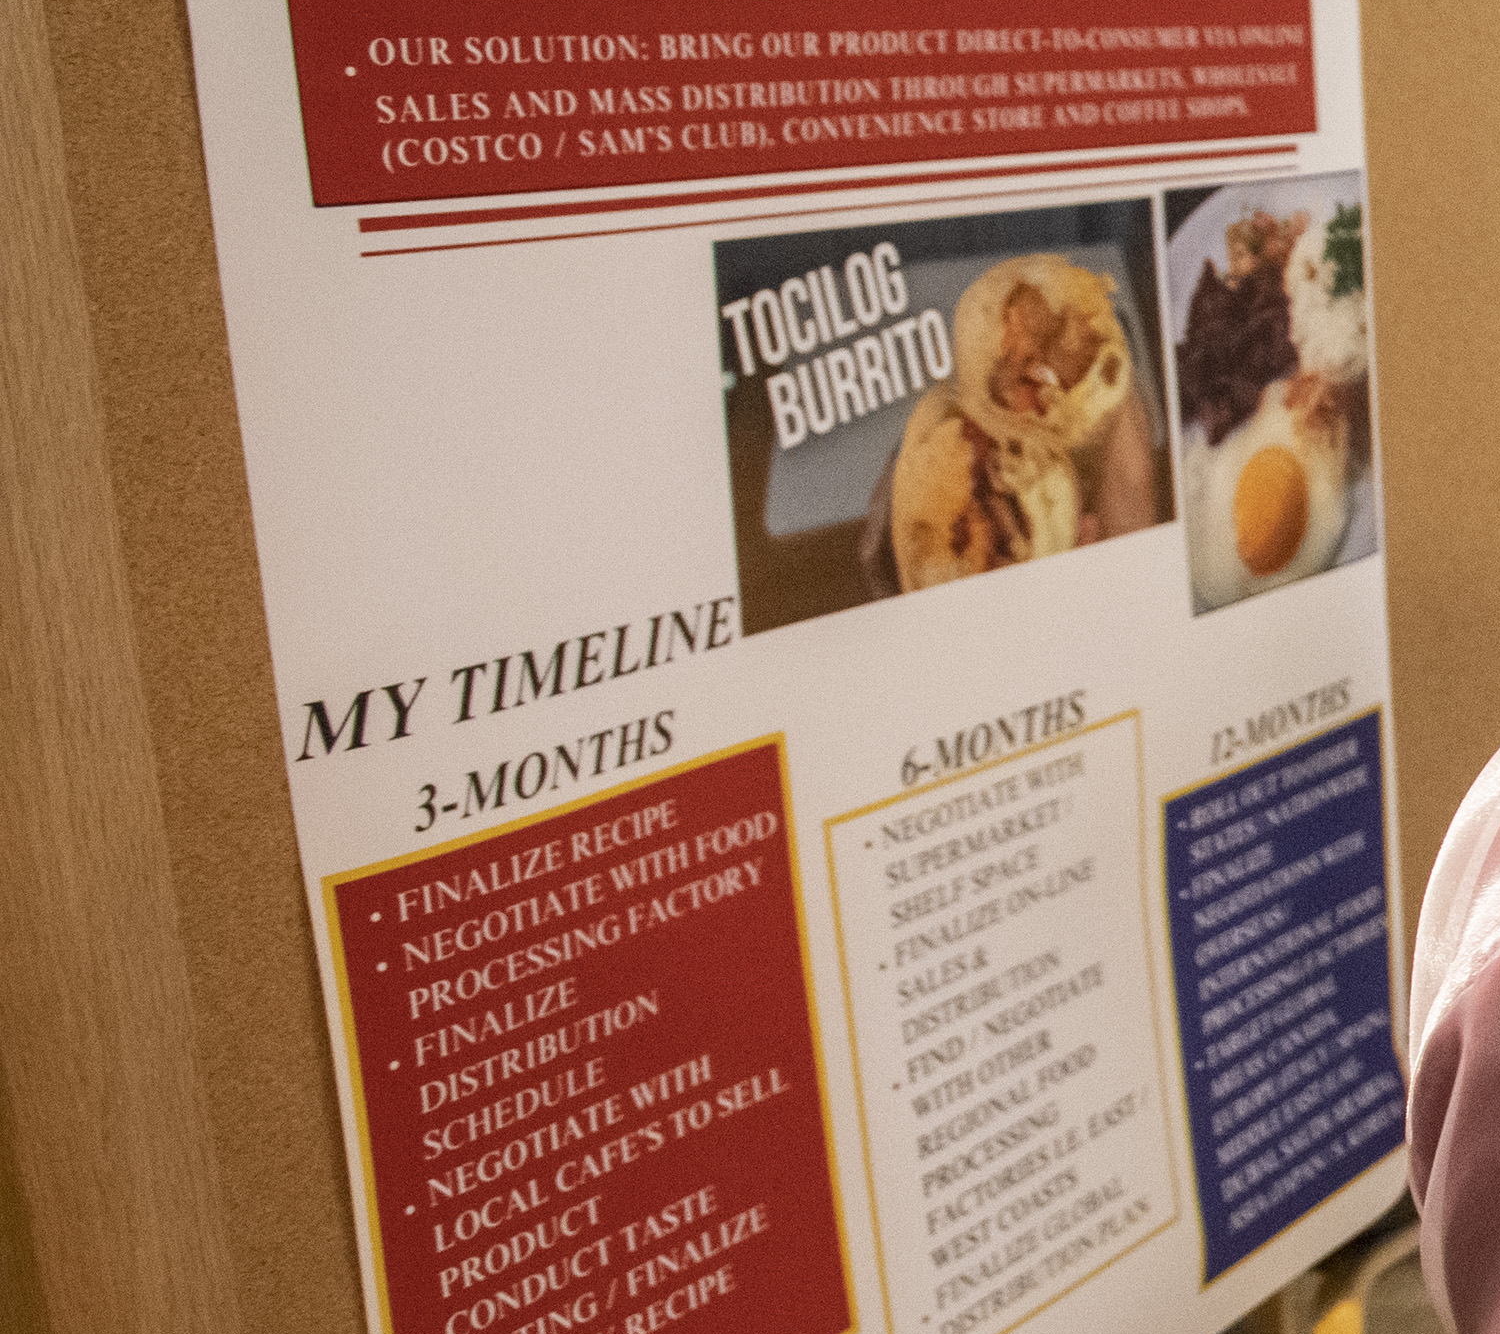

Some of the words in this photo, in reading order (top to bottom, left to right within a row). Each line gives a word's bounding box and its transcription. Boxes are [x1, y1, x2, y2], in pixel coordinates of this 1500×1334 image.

[368, 37, 452, 66] OUR
[464, 35, 648, 64] SOLUTION:
[659, 33, 753, 60] BRING
[761, 31, 820, 57] OUR
[829, 29, 948, 56] PRODUCT
[375, 92, 491, 124] SALES
[507, 89, 578, 118] AND
[589, 86, 672, 115] MASS
[682, 78, 881, 111] DISTRIBUTION
[890, 73, 1009, 101] THROUGH
[382, 133, 543, 171] (COSTCO
[554, 131, 567, 158] /
[578, 126, 673, 156] SAM'S
[782, 109, 964, 144] CONVENIENCE
[971, 105, 1043, 131] STORE
[1054, 102, 1101, 127] AND
[721, 241, 908, 376] TOCILOG
[766, 309, 951, 450] BURRITO
[295, 677, 427, 763] MY
[450, 596, 736, 725] TIMELINE
[414, 709, 676, 834] 3-MONTHS
[897, 688, 1089, 790] 6-MONTHS
[397, 840, 563, 922] FINALIZE
[570, 799, 677, 863] RECIPE
[880, 775, 1019, 844] NEGOTIATE
[402, 874, 604, 971] NEGOTIATE
[609, 841, 689, 892] WITH
[695, 811, 778, 862] FOOD
[408, 914, 621, 1020] PROCESSING
[627, 861, 760, 935] FACTORY
[894, 898, 1001, 968] FINALIZE
[414, 977, 576, 1067] FINALIZE
[901, 951, 1061, 1045] DISTRIBUTION
[420, 995, 659, 1114] DISTRIBUTION
[423, 1057, 604, 1160] SCHEDULE
[428, 1097, 623, 1198] NEGOTIATE
[629, 1054, 712, 1109] WITH
[433, 1179, 548, 1253] LOCAL
[554, 1121, 665, 1193] CAFE'S
[669, 1100, 713, 1138] TO
[716, 1068, 786, 1117] SELL
[439, 1195, 600, 1299] PRODUCT
[605, 1277, 618, 1310] /
[626, 1207, 766, 1297] FINALIZE
[621, 1188, 715, 1252] TASTE
